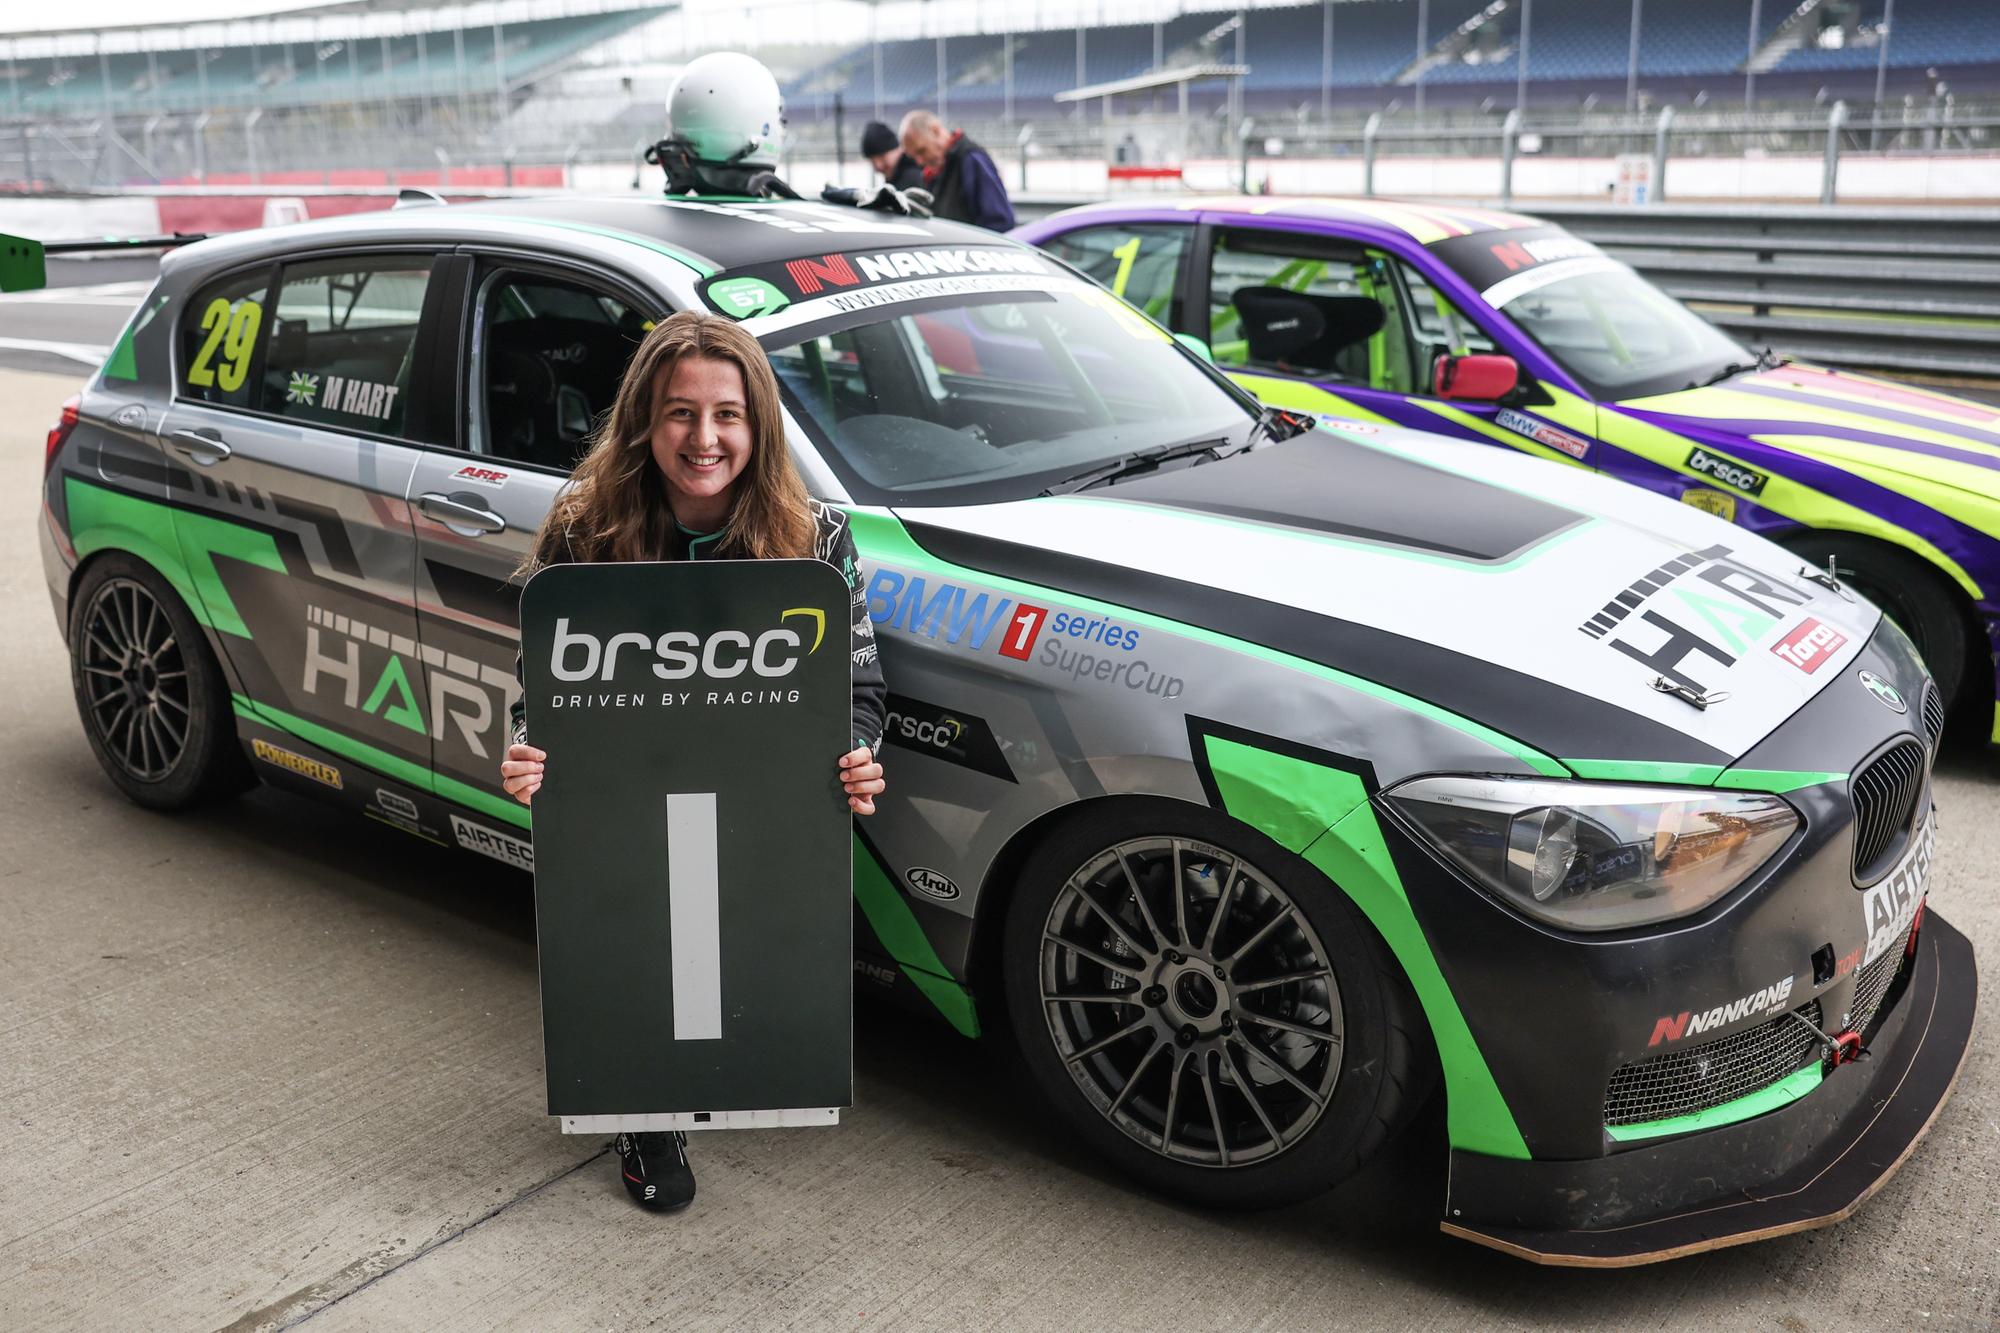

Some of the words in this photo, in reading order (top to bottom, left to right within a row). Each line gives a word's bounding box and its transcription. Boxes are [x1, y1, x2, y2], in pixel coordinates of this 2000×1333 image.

[1113, 236, 1141, 297] 1
[728, 288, 765, 307] 57
[188, 298, 262, 392] 29
[321, 376, 343, 410] M
[342, 379, 399, 420] HART
[458, 466, 509, 481] ARP
[1691, 450, 1754, 490] brscc
[865, 568, 1012, 649] BMW
[1015, 611, 1038, 651] 1
[1052, 611, 1140, 652] series
[550, 617, 800, 682] brscc
[1775, 622, 1836, 668] Torco
[1039, 638, 1185, 700] SuperCup
[552, 694, 645, 708] DRIVEN
[661, 693, 691, 706] BY
[706, 690, 801, 705] RACING
[884, 711, 951, 749] rscc
[254, 740, 340, 787] POWERFLEX
[457, 822, 535, 862] AIRTEC
[910, 871, 954, 894] Arai
[1685, 975, 1794, 1037] NANKANG
